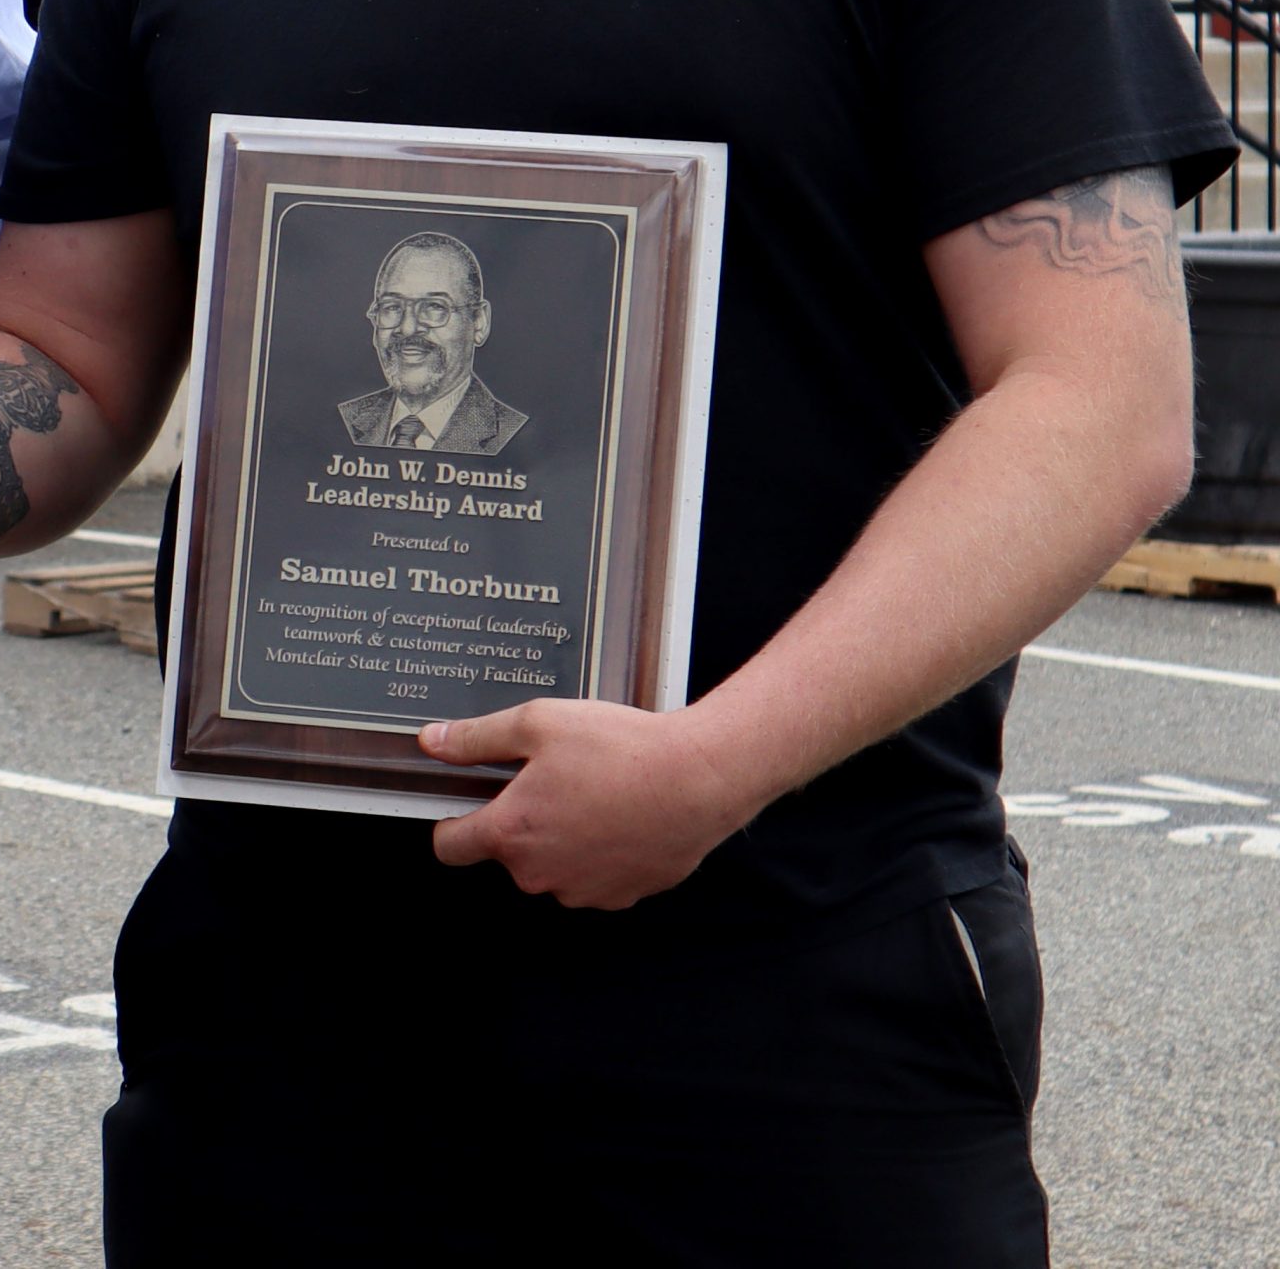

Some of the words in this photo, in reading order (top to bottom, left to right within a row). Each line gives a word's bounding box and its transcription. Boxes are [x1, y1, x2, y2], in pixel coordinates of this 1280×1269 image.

[327, 455, 390, 480] John
[399, 460, 426, 482] W.
[436, 463, 527, 490] Dennis
[306, 482, 450, 518] Leadership
[458, 495, 543, 521] Award
[371, 532, 450, 552] Presented
[454, 538, 469, 553] to
[281, 558, 397, 590] Samuel
[408, 568, 560, 604] Thorburn
[258, 598, 275, 613] In
[280, 602, 367, 622] recognition
[373, 607, 391, 628] of
[392, 611, 482, 632] exceptional
[487, 616, 571, 644] leadership,
[284, 625, 363, 645] teamwork
[368, 633, 384, 647] &
[390, 636, 461, 654] customer
[466, 642, 520, 658] service
[526, 647, 542, 661] to
[265, 647, 345, 667] Montclair
[348, 654, 390, 672] State
[395, 658, 480, 685] University
[483, 666, 556, 687] Facilities
[387, 682, 430, 699] 2022
